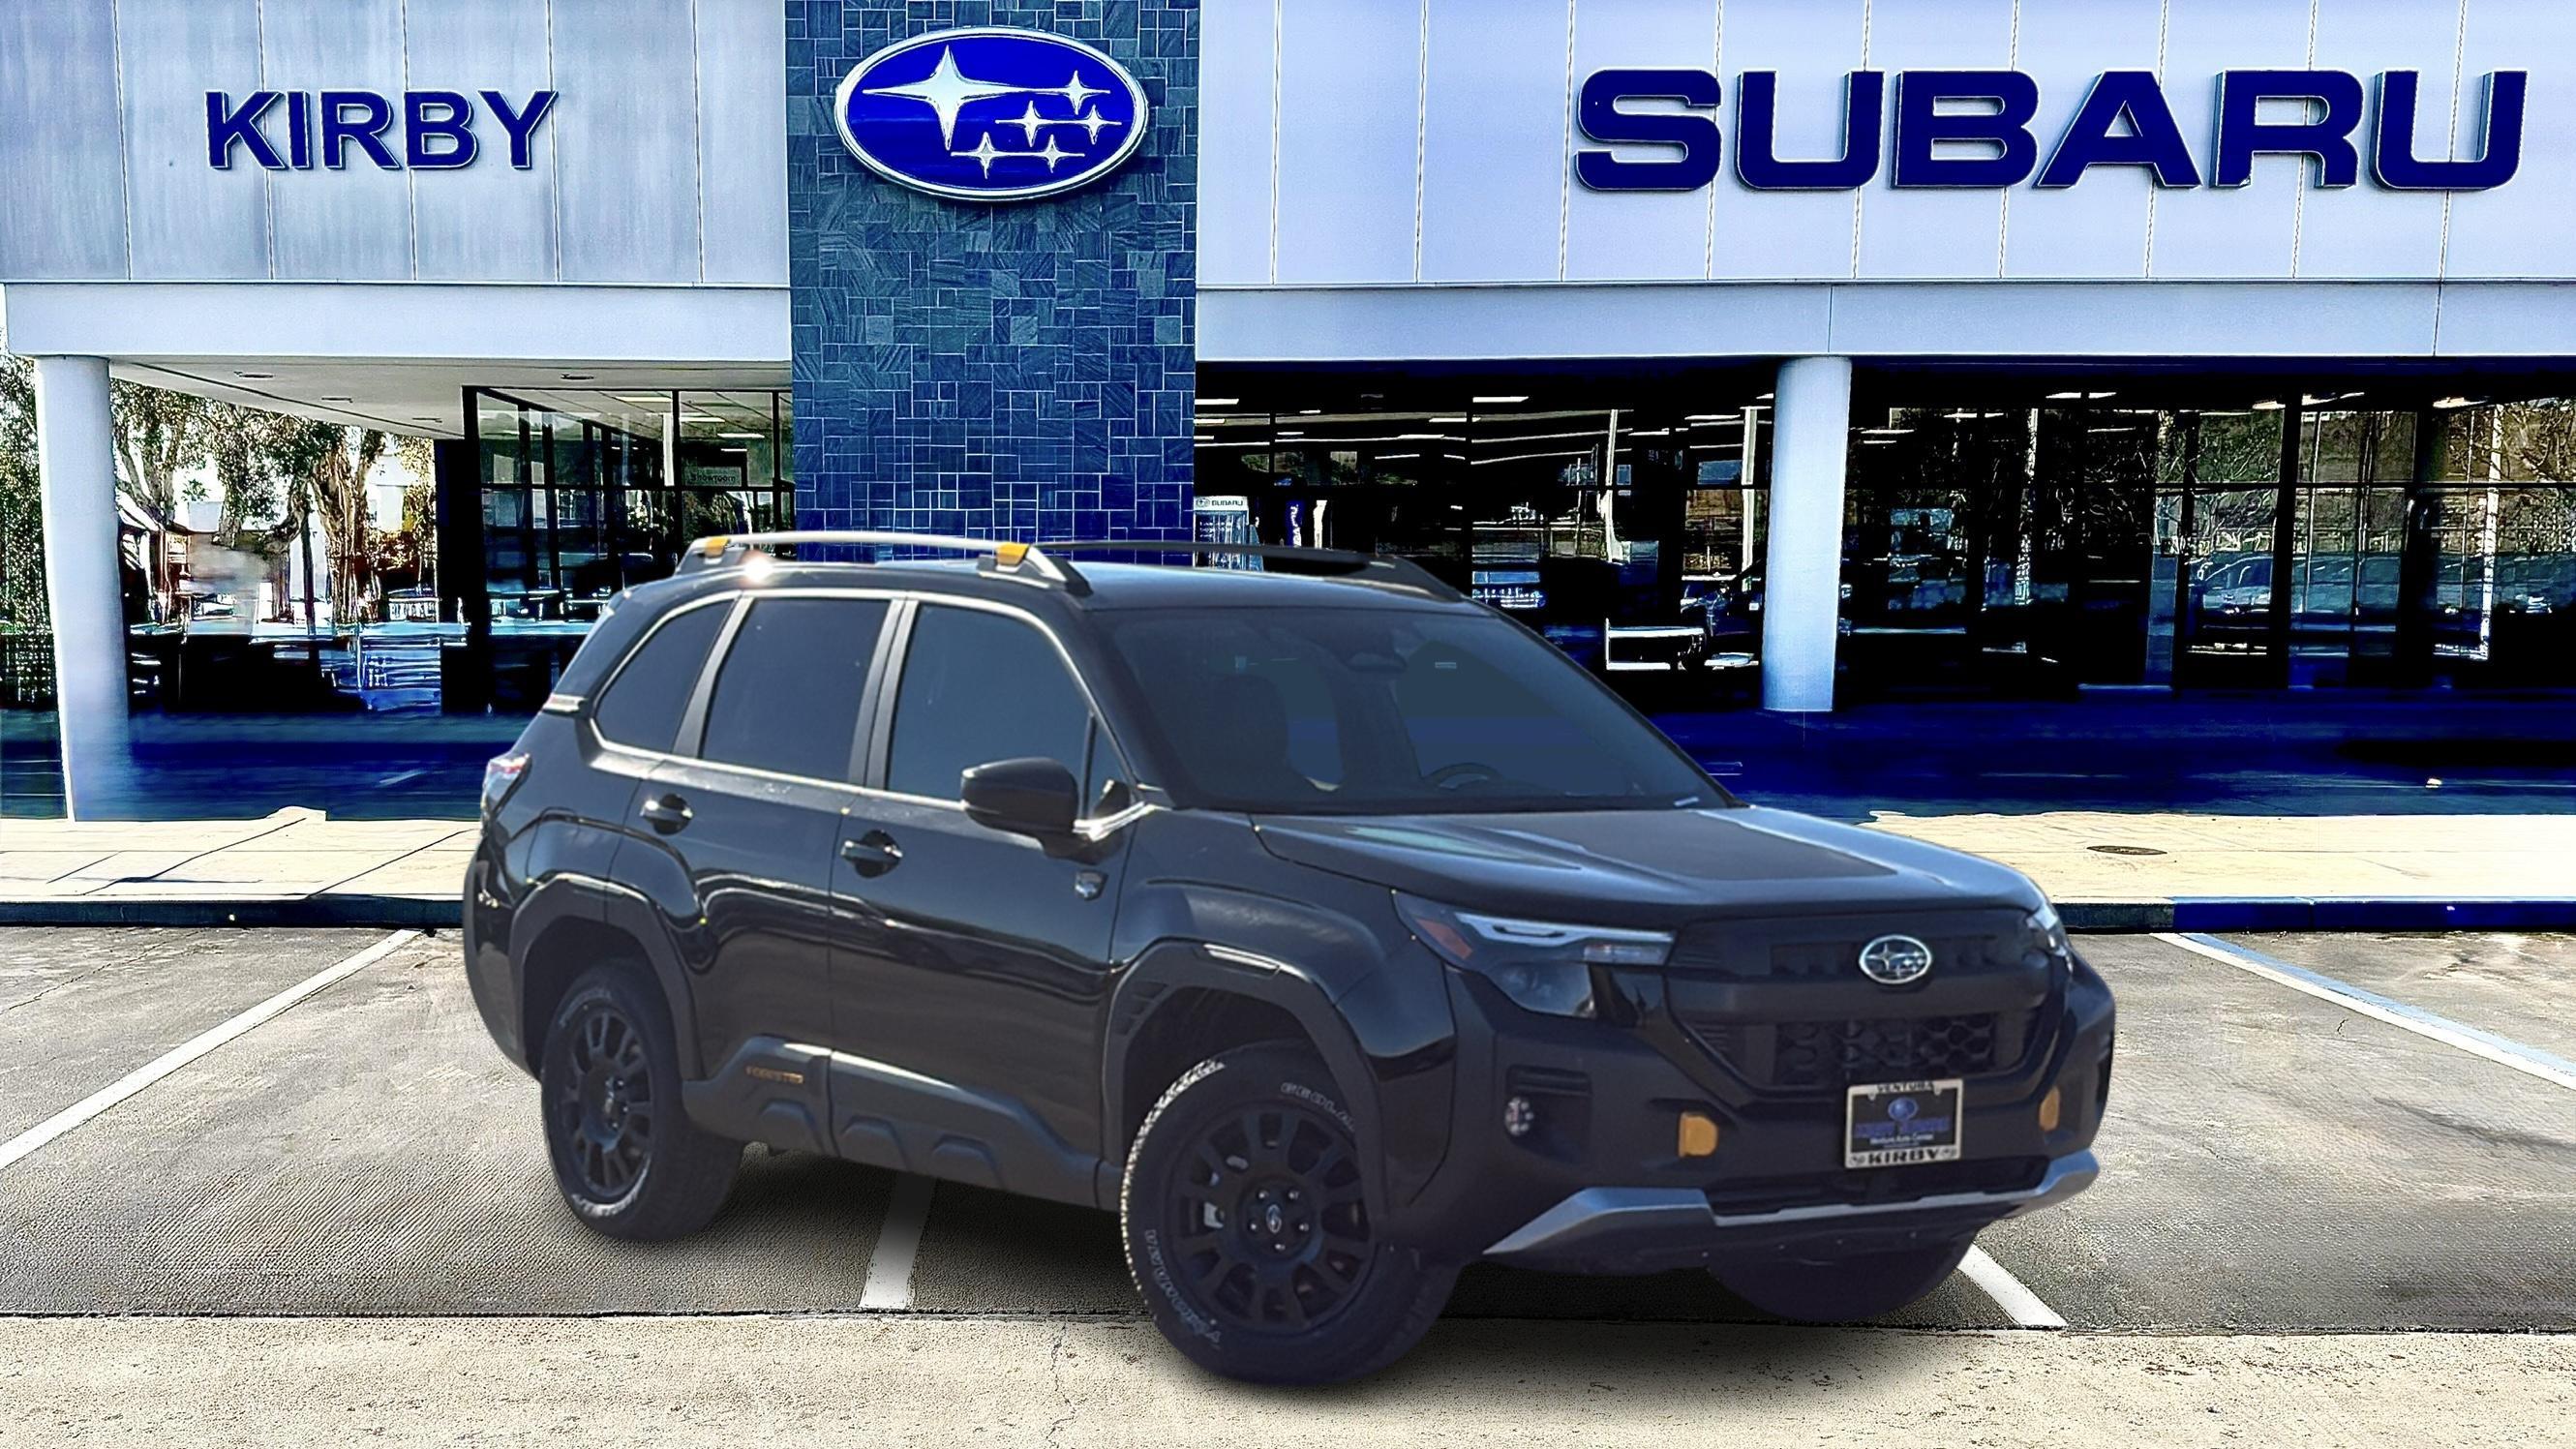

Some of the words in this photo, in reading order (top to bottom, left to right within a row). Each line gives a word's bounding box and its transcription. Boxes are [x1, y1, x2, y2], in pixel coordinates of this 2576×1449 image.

[204, 90, 560, 170] KIRBY
[1574, 68, 2526, 191] SUBARU
[1867, 1148, 1939, 1164] KIRBY
